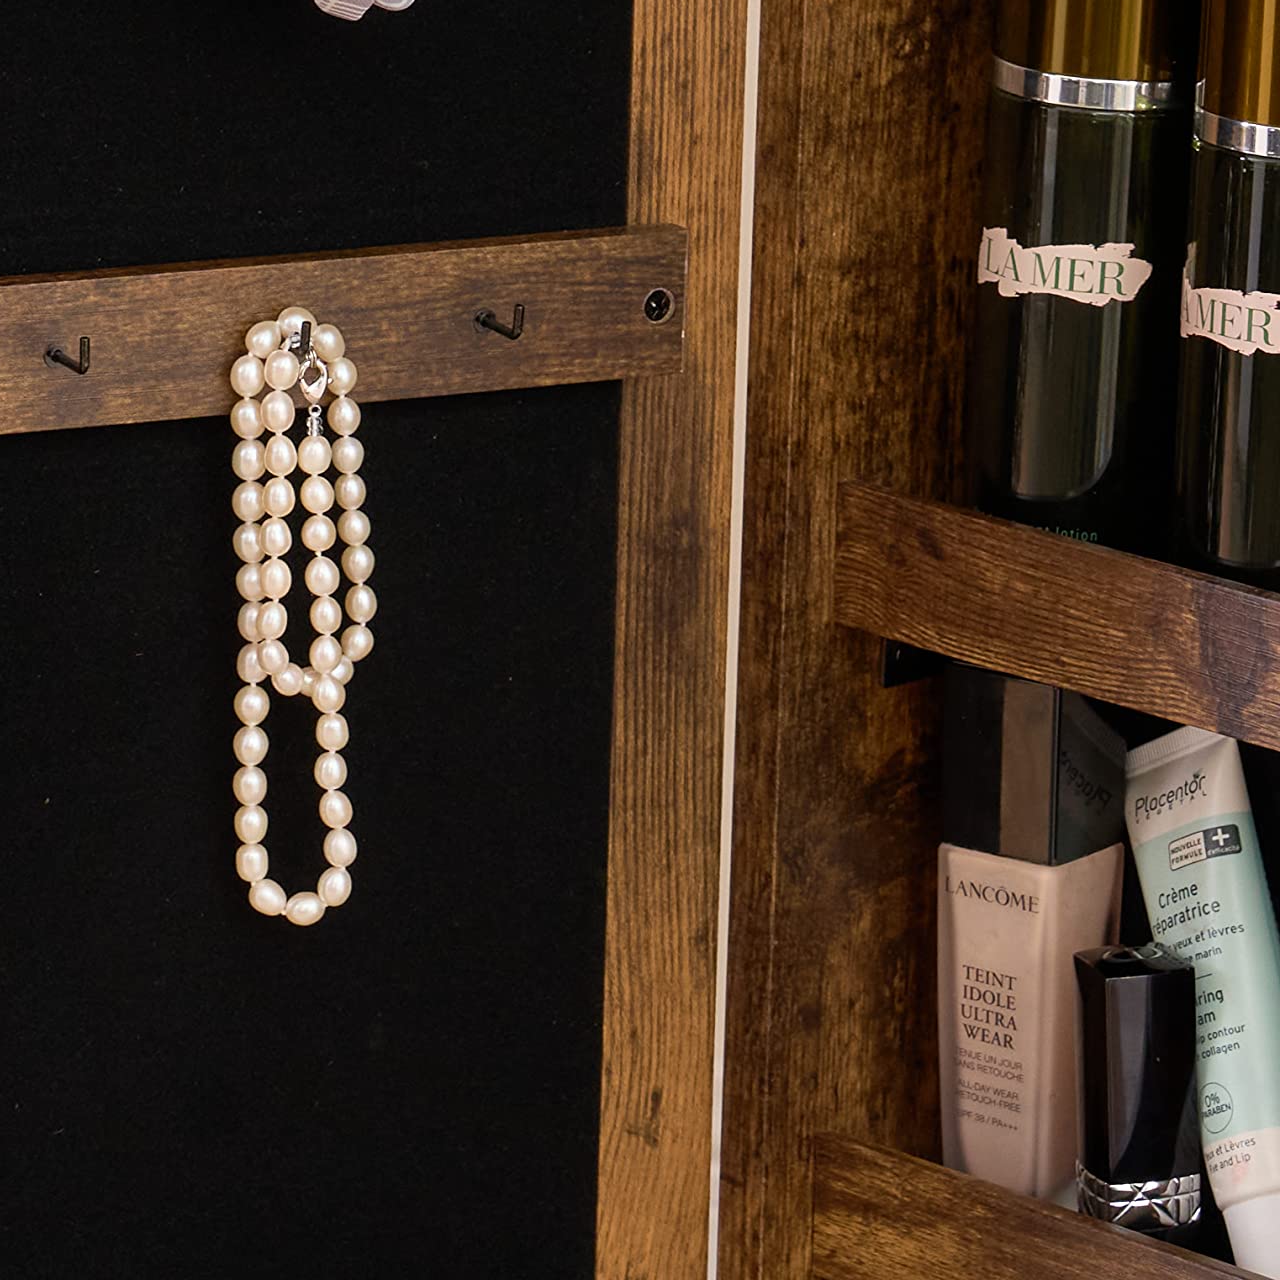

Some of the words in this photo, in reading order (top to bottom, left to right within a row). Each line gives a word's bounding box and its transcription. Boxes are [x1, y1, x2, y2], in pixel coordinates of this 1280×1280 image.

[984, 237, 1022, 282] LA
[1030, 252, 1128, 296] MER
[1194, 292, 1274, 347] MER
[1135, 775, 1206, 818] Placentor
[945, 876, 1040, 914] LANCÔME
[1158, 883, 1198, 909] Crème
[1152, 900, 1221, 936] réparatrice
[1195, 930, 1205, 943] et
[1208, 924, 1245, 939] lèvres
[1195, 946, 1223, 961] marin
[962, 965, 1017, 991] TEINT
[963, 984, 1017, 1011] IDOLE
[1197, 989, 1224, 1006] ring
[960, 1003, 1017, 1031] ULTRA
[1197, 1011, 1216, 1026] am
[963, 1022, 1015, 1050] WEAR
[1208, 1024, 1246, 1041] contour
[1201, 1041, 1240, 1059] collagen
[1204, 1092, 1221, 1108] 0%
[1224, 1137, 1256, 1153] Lèvres
